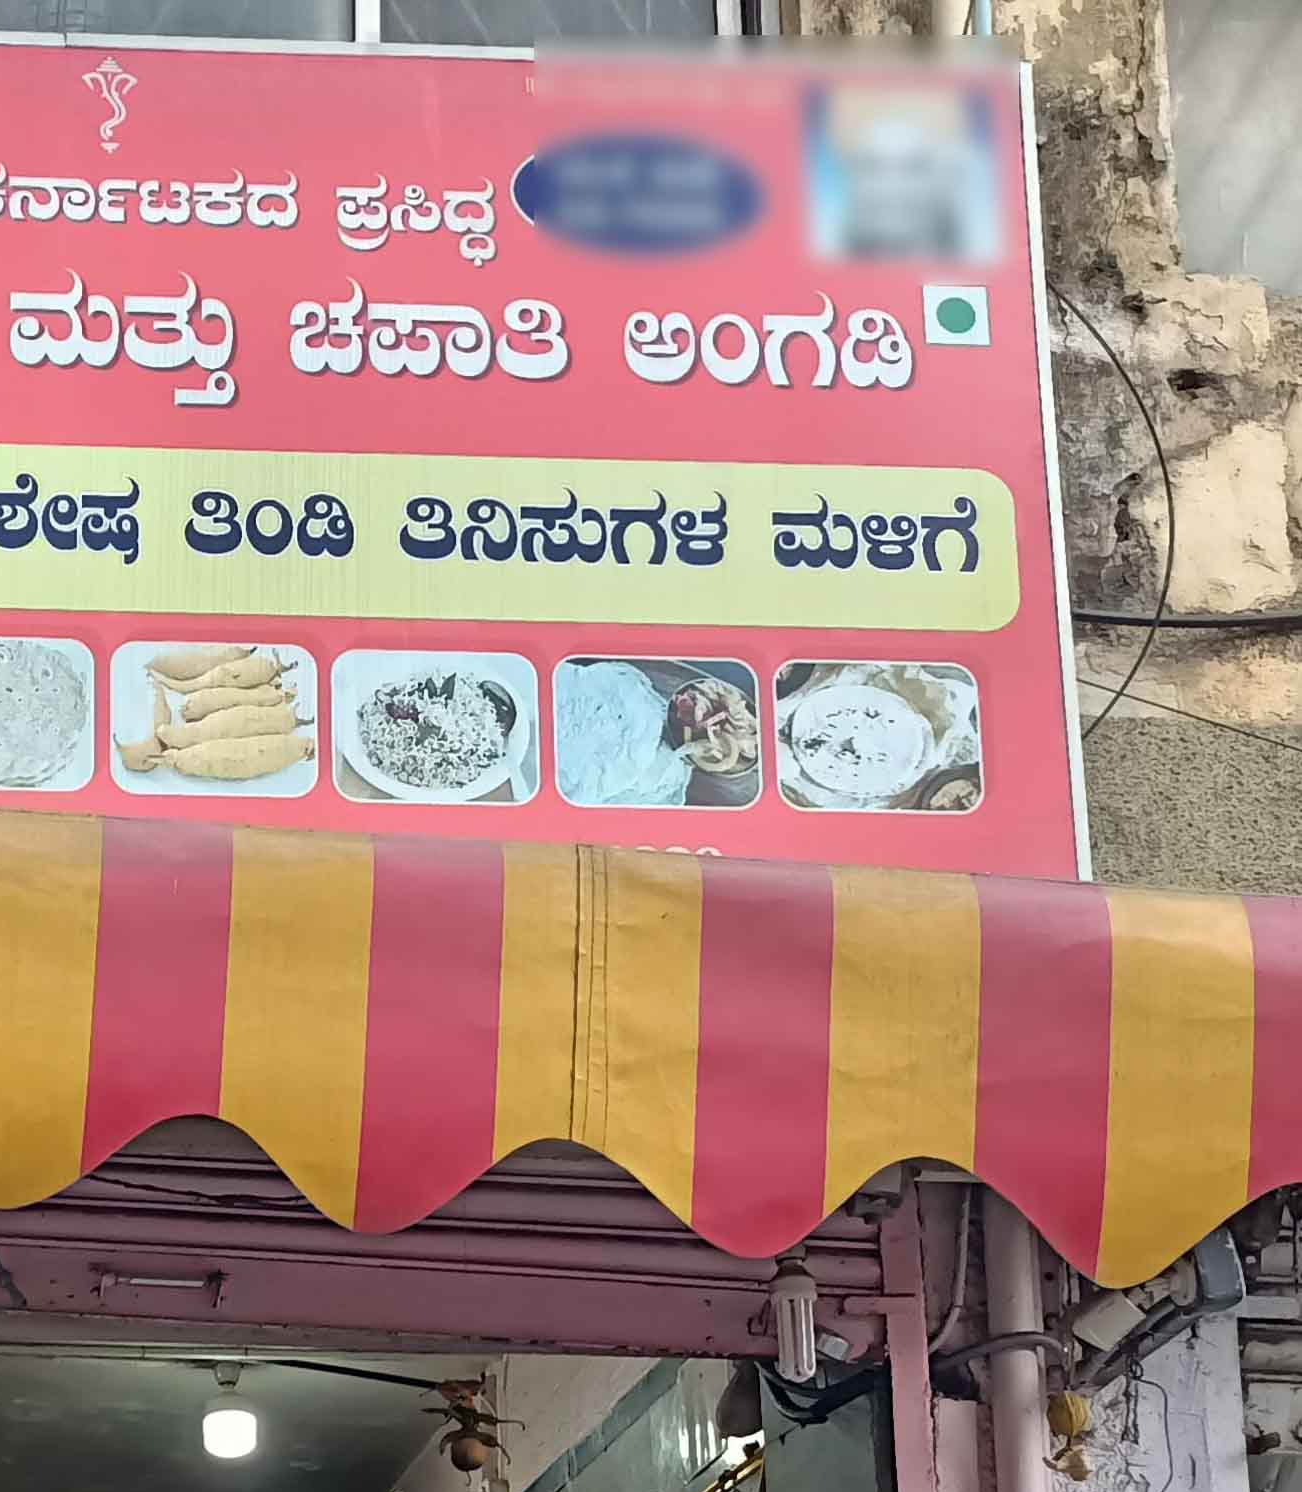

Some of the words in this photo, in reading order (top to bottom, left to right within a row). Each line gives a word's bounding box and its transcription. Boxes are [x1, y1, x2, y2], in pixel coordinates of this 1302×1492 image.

[334, 174, 499, 268] ಪ್ರಸಿದ್ಧ
[8, 270, 238, 408] ಮತ್ತು
[288, 277, 570, 381] ಚಪಾತಿ
[623, 291, 915, 390] ಅಂಗಡಿ
[183, 490, 355, 559] ತಿಂಡಿ
[398, 487, 729, 567] ತಿನಿಸುಗಳ
[771, 493, 980, 573] ಮಳಿಗೆ
